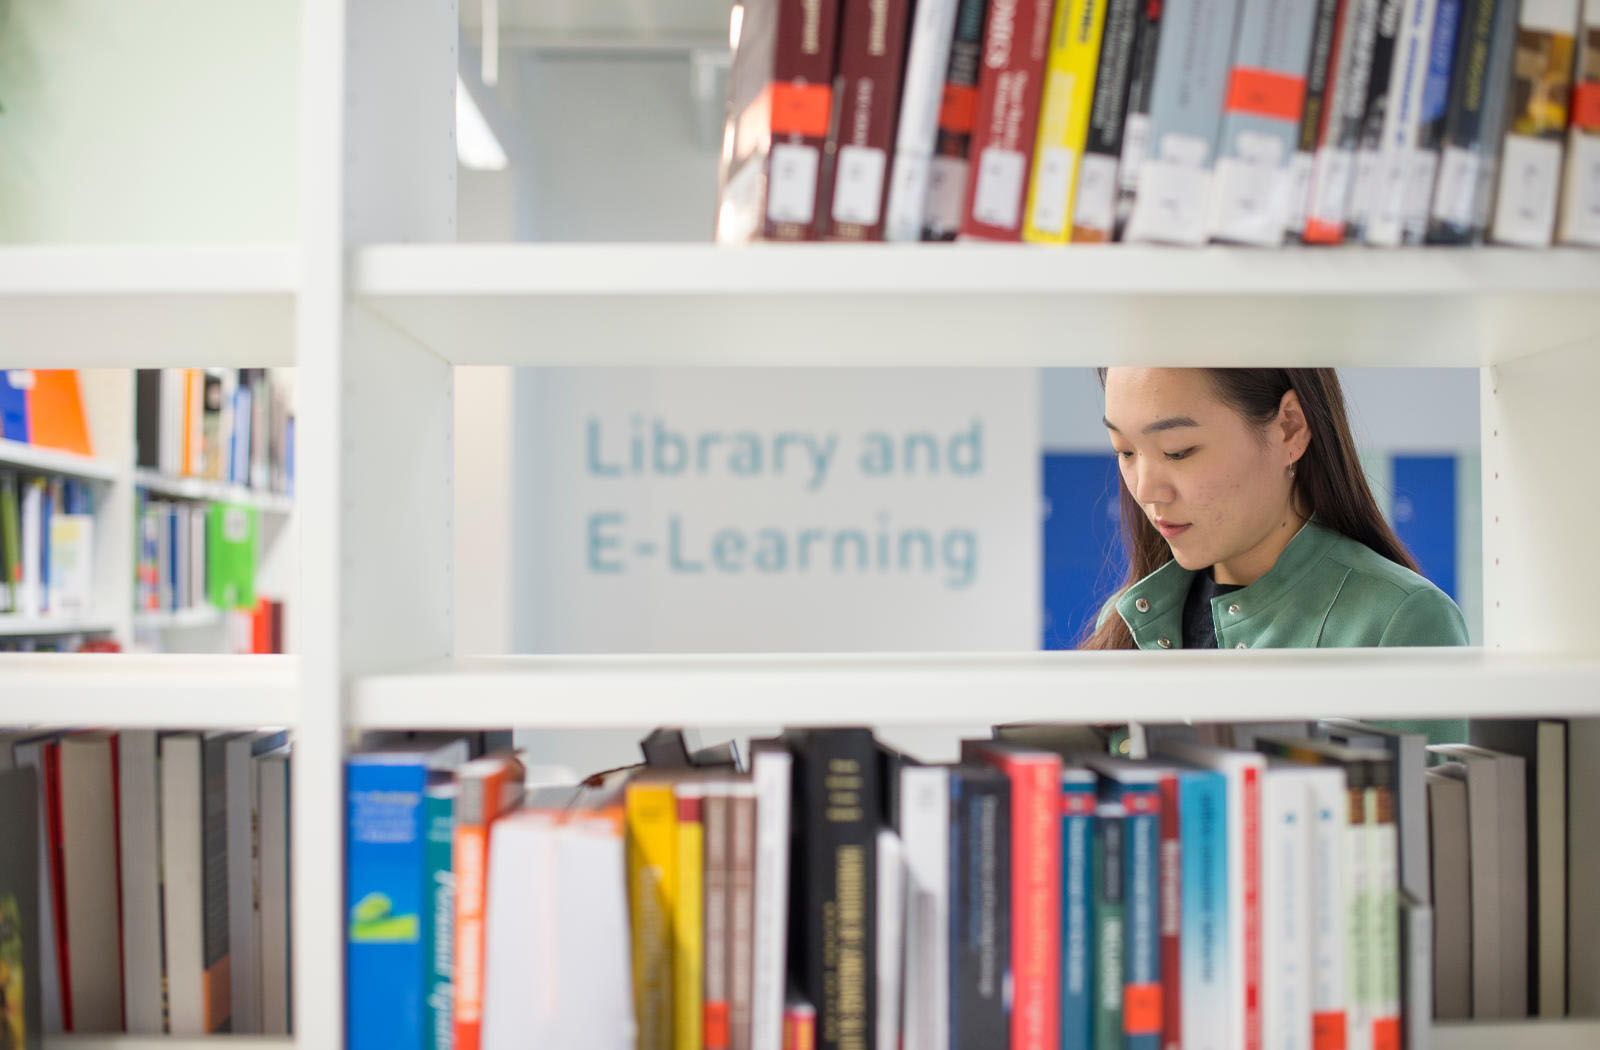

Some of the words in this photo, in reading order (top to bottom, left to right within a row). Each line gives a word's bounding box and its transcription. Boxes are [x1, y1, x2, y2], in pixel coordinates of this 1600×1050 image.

[586, 415, 840, 492] Library
[859, 414, 985, 478] and
[586, 510, 979, 591] E-Learning
